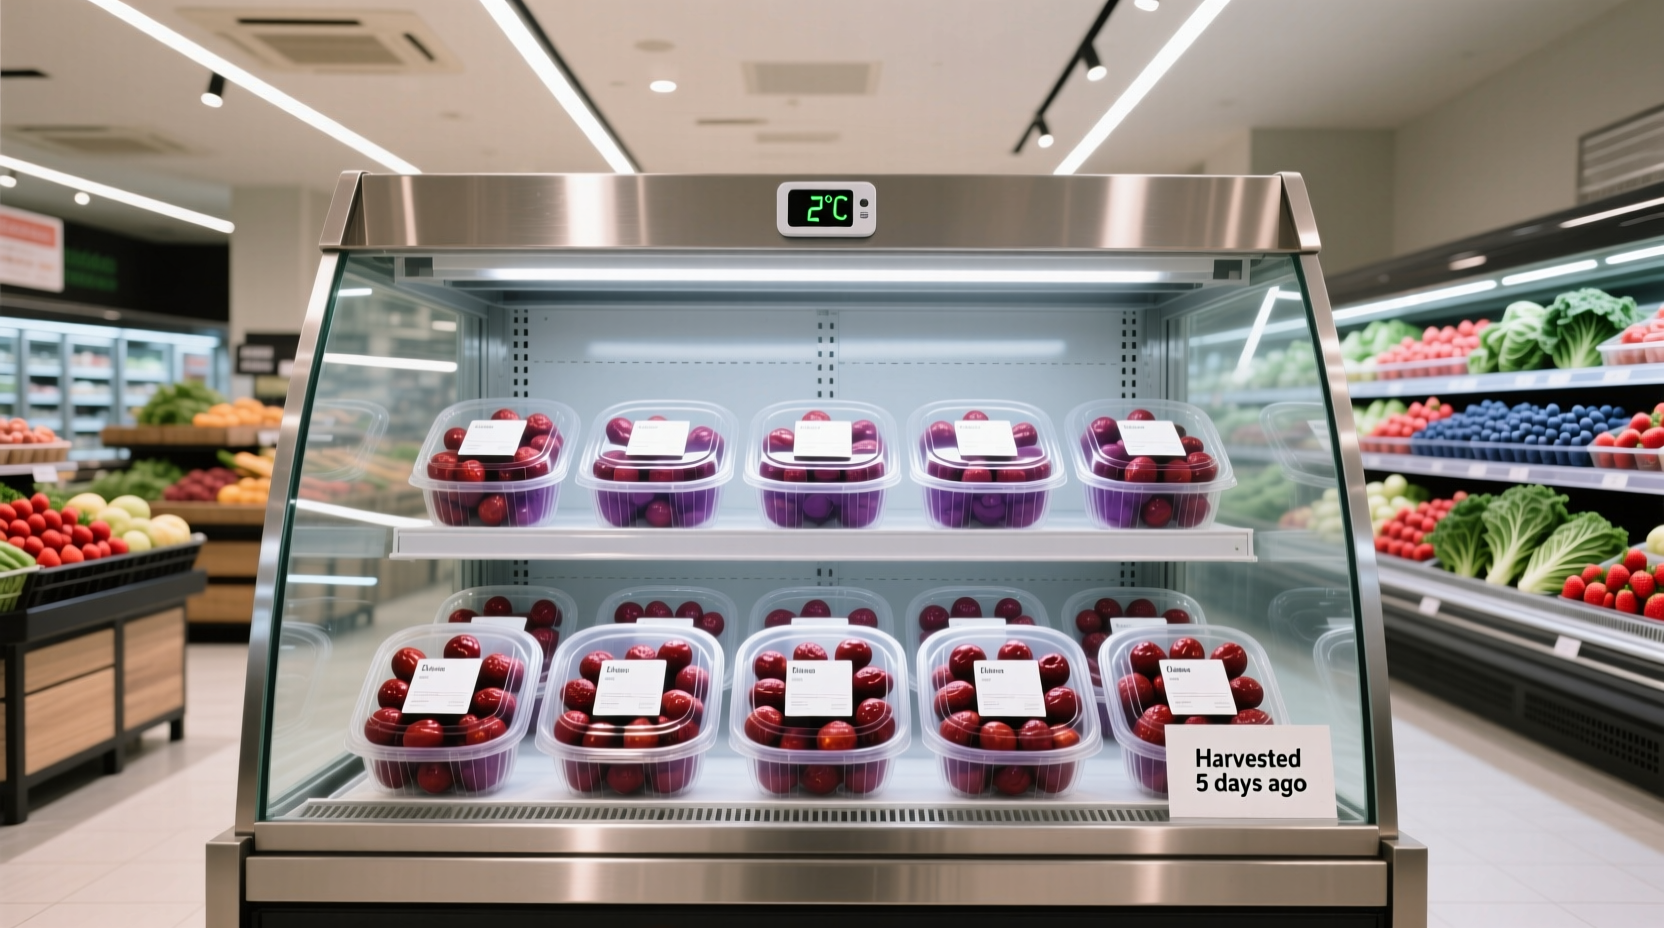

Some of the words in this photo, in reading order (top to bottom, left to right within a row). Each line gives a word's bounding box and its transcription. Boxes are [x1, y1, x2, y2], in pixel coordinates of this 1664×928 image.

[807, 194, 848, 222] 2°C
[1196, 748, 1301, 768] Harvested
[1196, 773, 1208, 792] 5
[1214, 772, 1262, 798] days
[1268, 777, 1307, 798] ago
